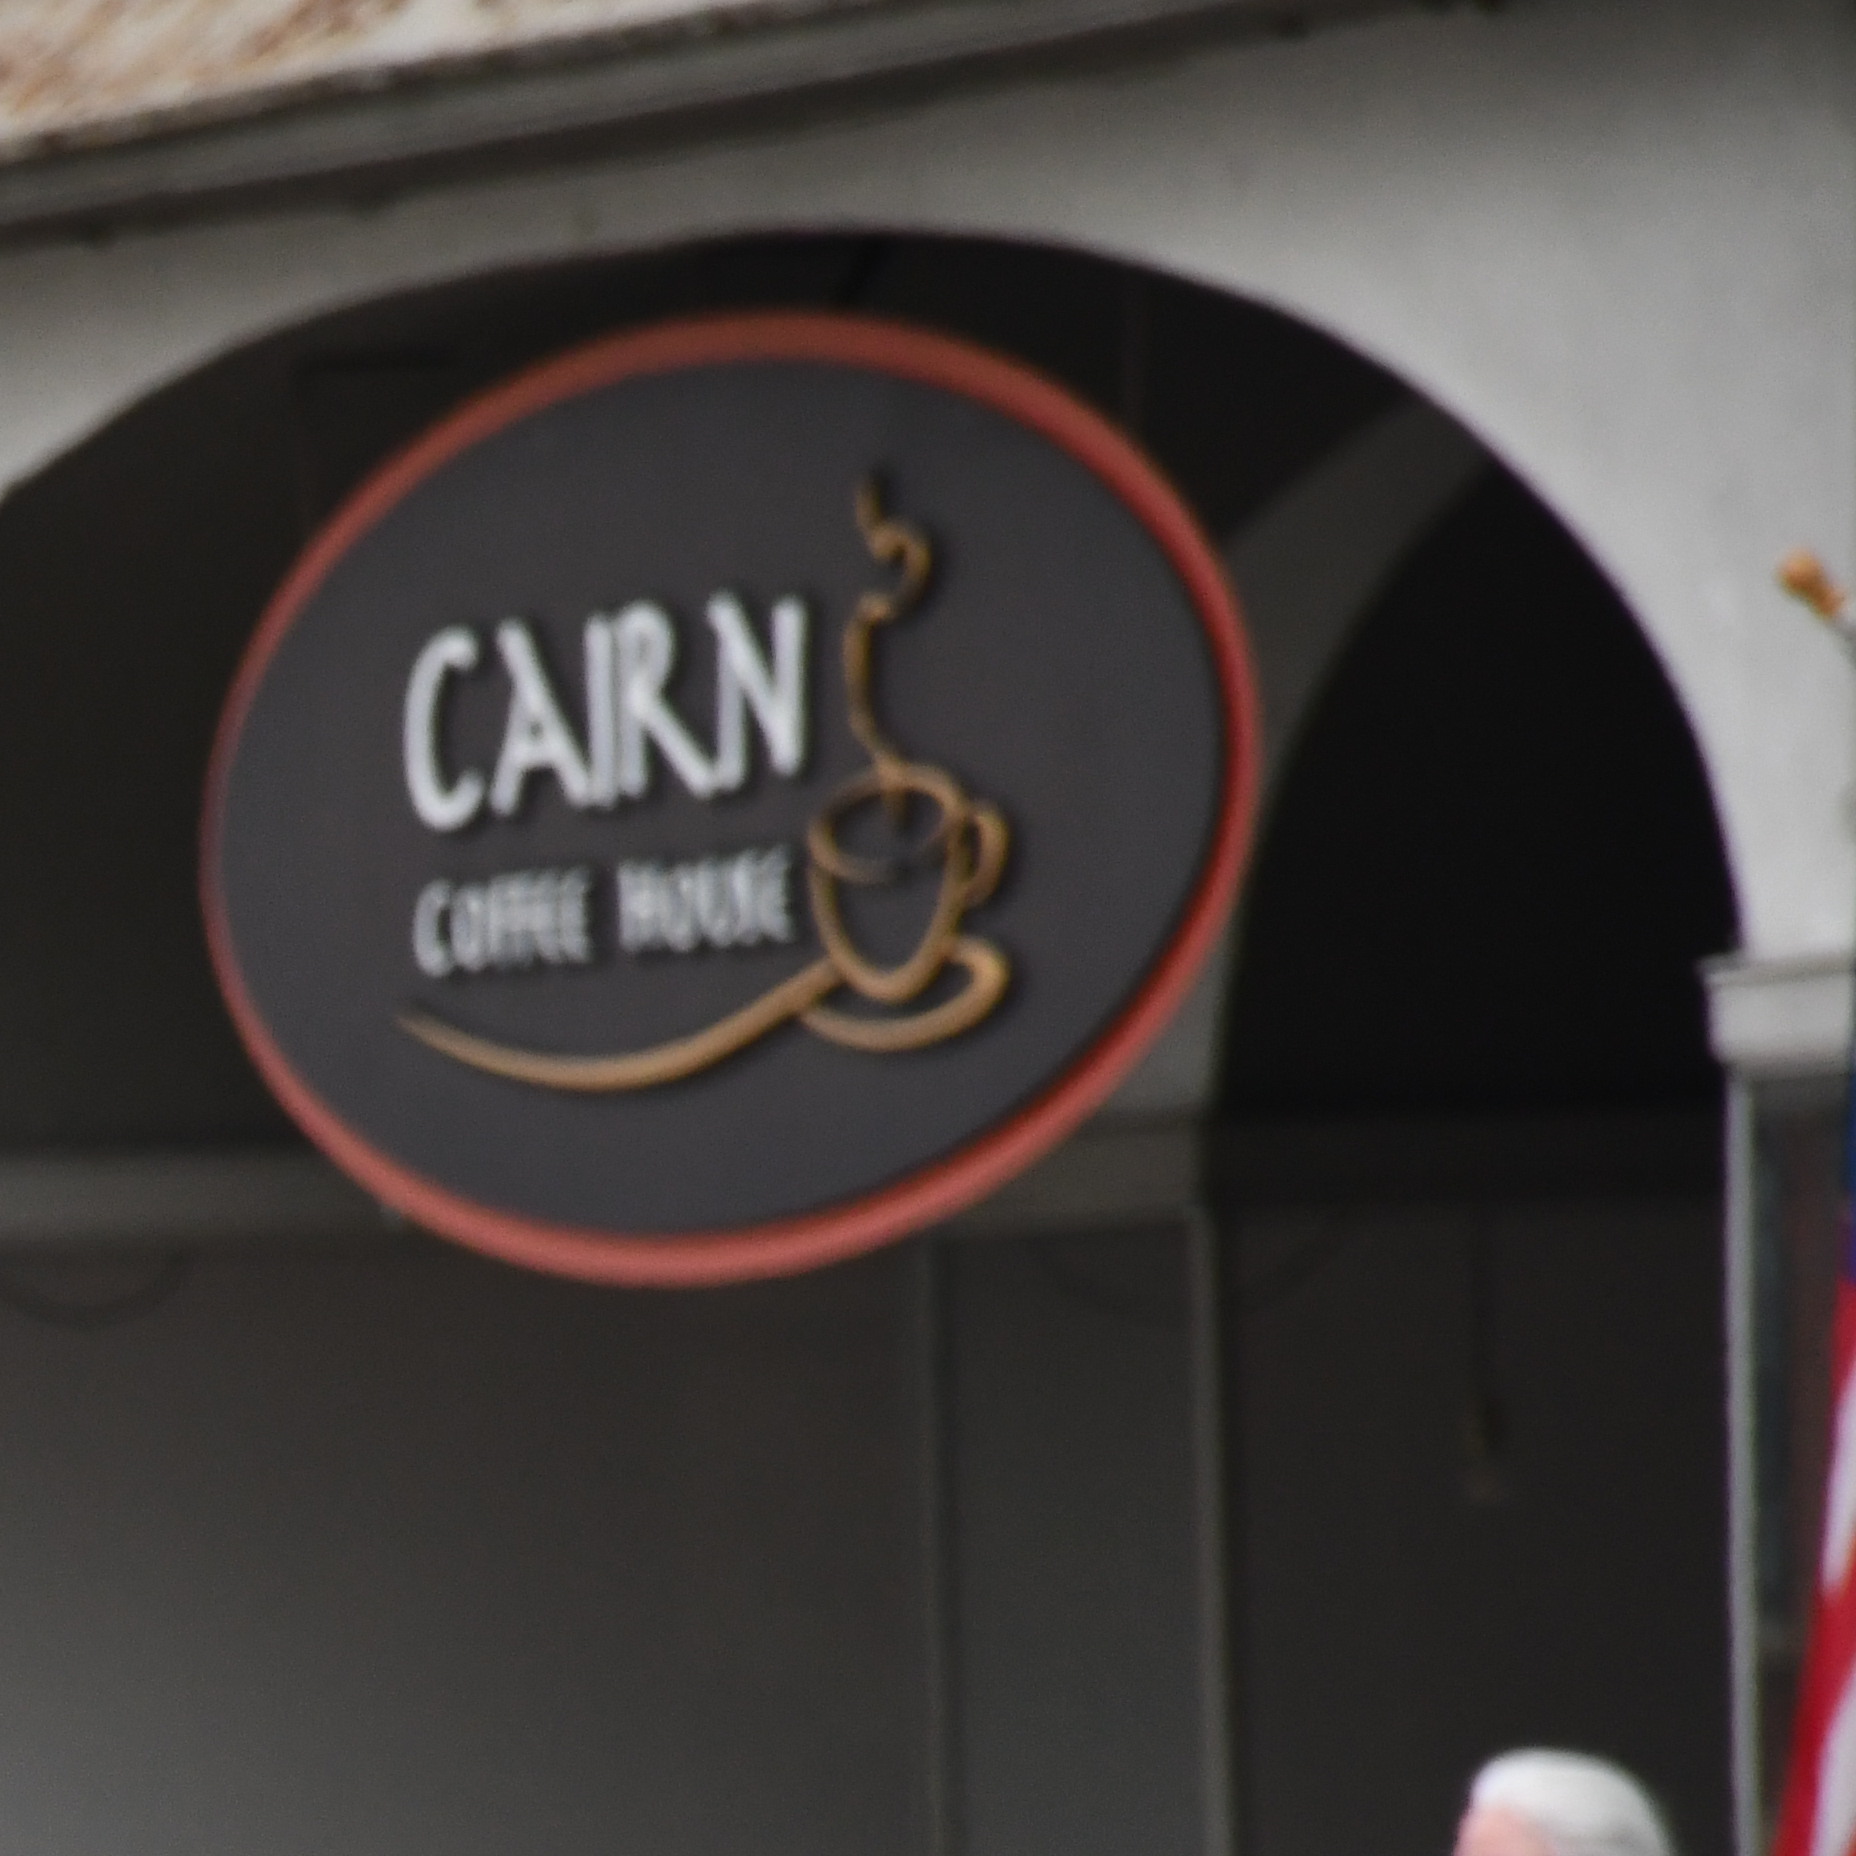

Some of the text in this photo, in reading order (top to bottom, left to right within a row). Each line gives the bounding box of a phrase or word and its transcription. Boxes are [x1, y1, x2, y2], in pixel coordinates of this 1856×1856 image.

[402, 588, 808, 832] CAIRN
[412, 842, 794, 978] COFFEE HOUSE
